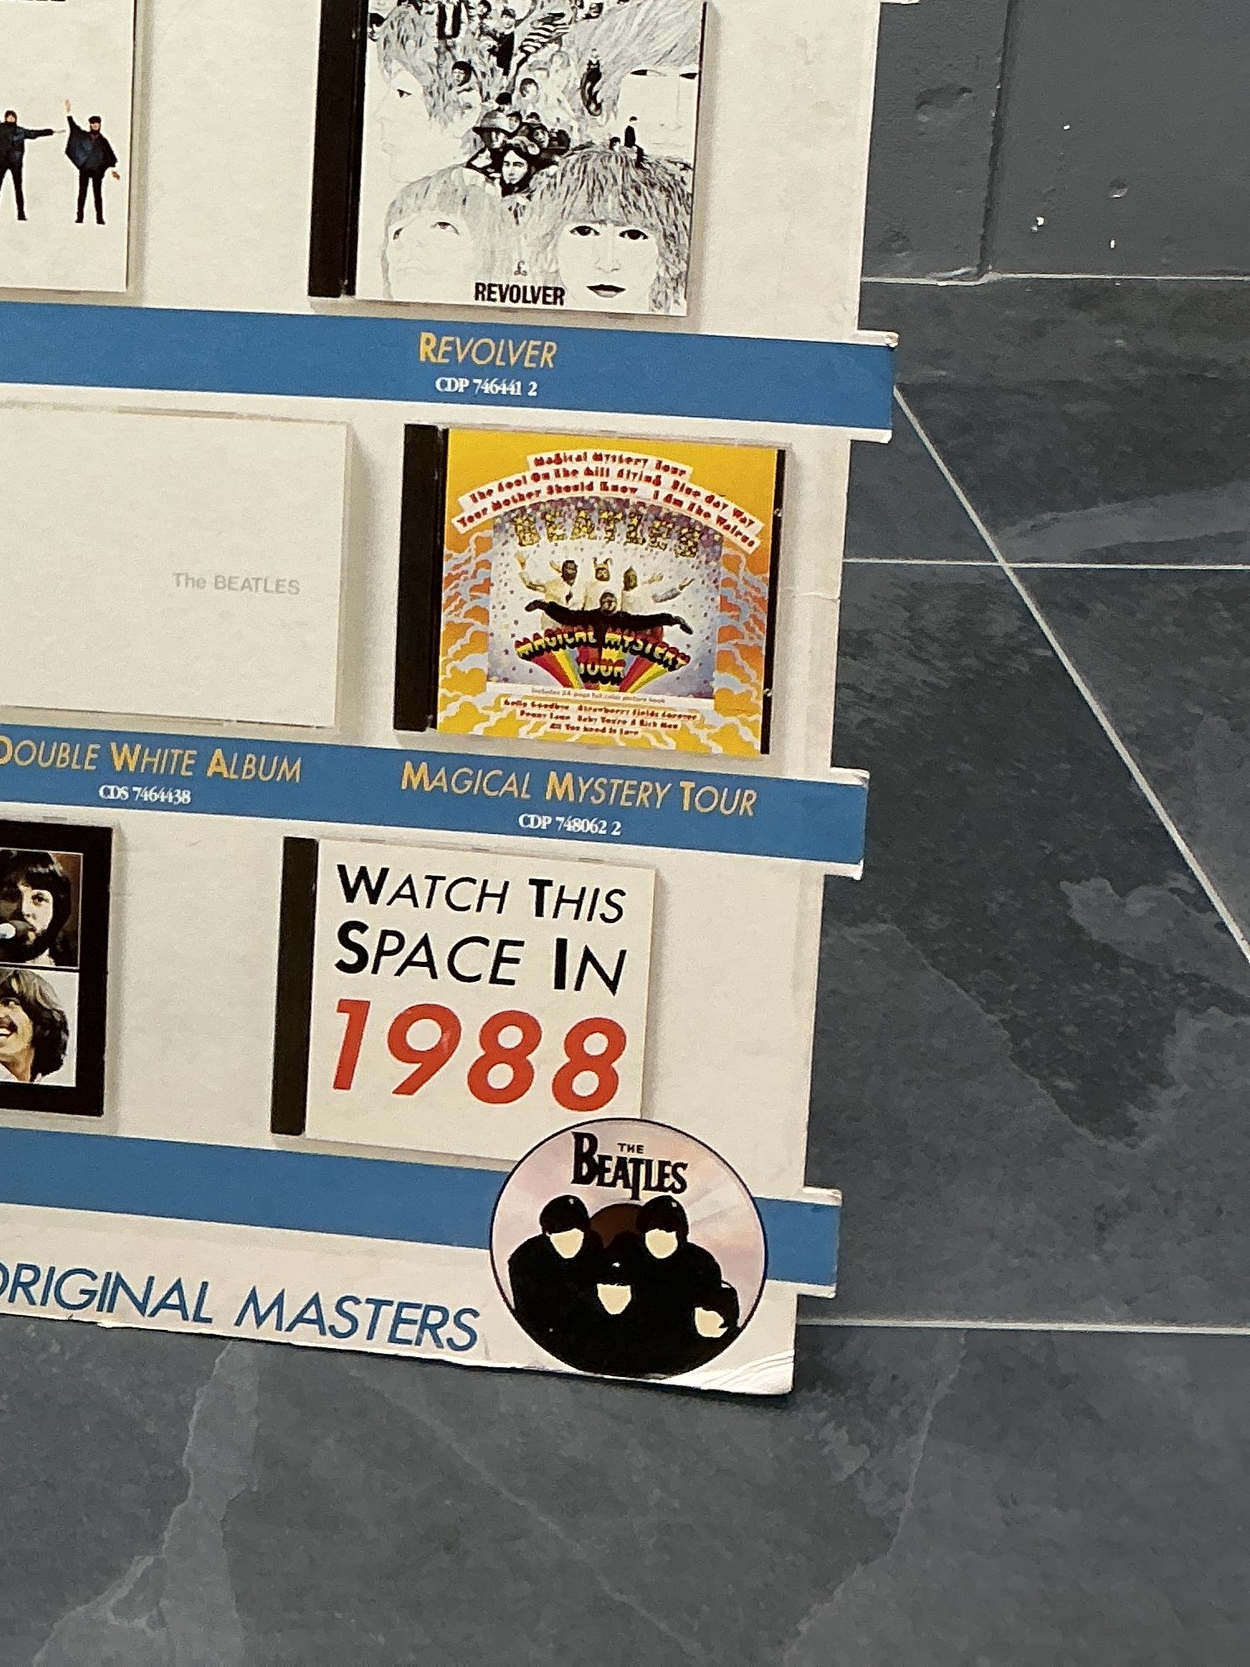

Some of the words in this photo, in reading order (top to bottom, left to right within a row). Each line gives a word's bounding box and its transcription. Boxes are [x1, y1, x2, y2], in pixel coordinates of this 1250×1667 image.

[474, 282, 566, 306] REVOLVER
[418, 331, 559, 368] REVOLVER
[435, 377, 468, 393] CDP
[473, 378, 522, 396] 746441
[528, 381, 537, 396] 2
[173, 572, 207, 589] The
[214, 575, 300, 596] BEATLES
[111, 741, 197, 776] WHITE
[207, 748, 302, 783] ALBUM
[99, 785, 129, 800] CDS
[400, 761, 530, 799] MAGICAL
[546, 770, 670, 808] MYSTERY
[680, 780, 758, 816] TOUR
[519, 814, 551, 829] CDP
[556, 816, 607, 834] 748062
[611, 821, 621, 835] 2
[337, 864, 509, 914] WATCH
[529, 877, 627, 925] THIS
[334, 921, 525, 986] SPACE
[553, 937, 627, 996] IN
[332, 999, 628, 1113] 1988
[571, 1132, 688, 1201] BEATLES
[617, 1143, 644, 1154] THE
[234, 1286, 481, 1352] MASTERS
